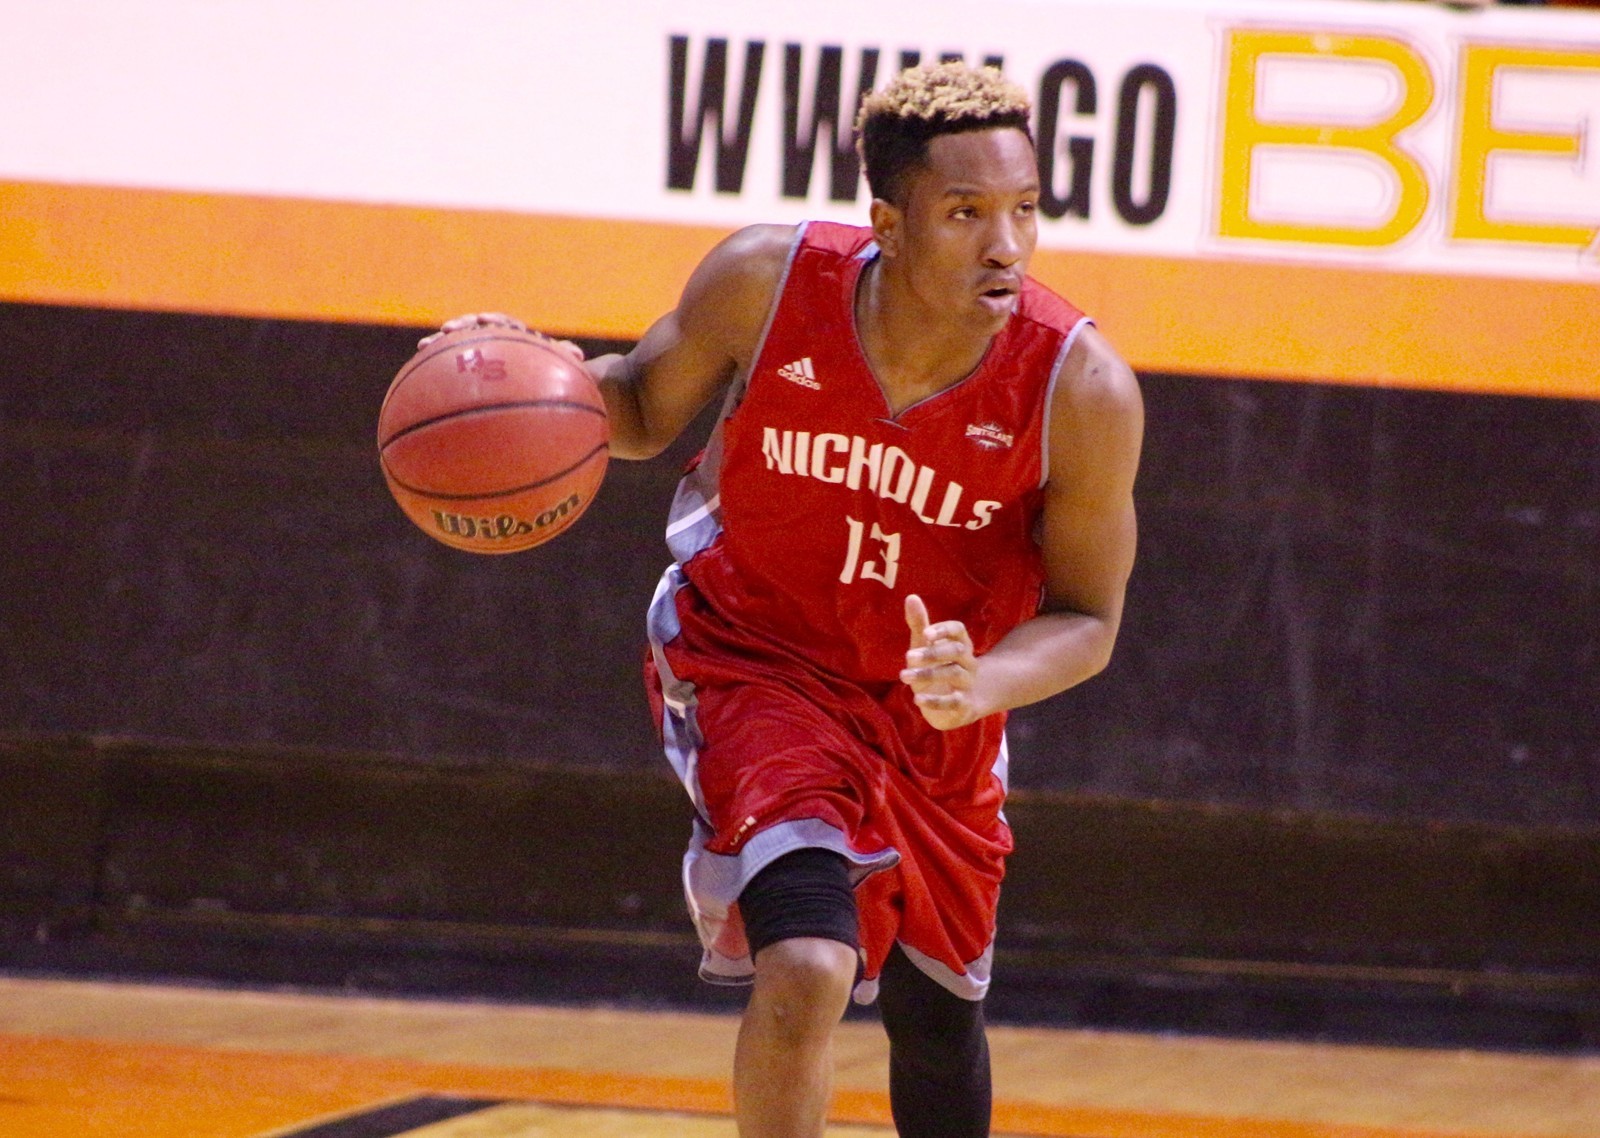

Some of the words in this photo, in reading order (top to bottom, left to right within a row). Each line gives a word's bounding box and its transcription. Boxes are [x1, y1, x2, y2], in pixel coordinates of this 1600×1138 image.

[1213, 26, 1600, 250] BE
[777, 368, 822, 391] adidas
[430, 493, 580, 540] Wilson
[761, 426, 1003, 531] NICHOLLS
[838, 514, 902, 590] 13
